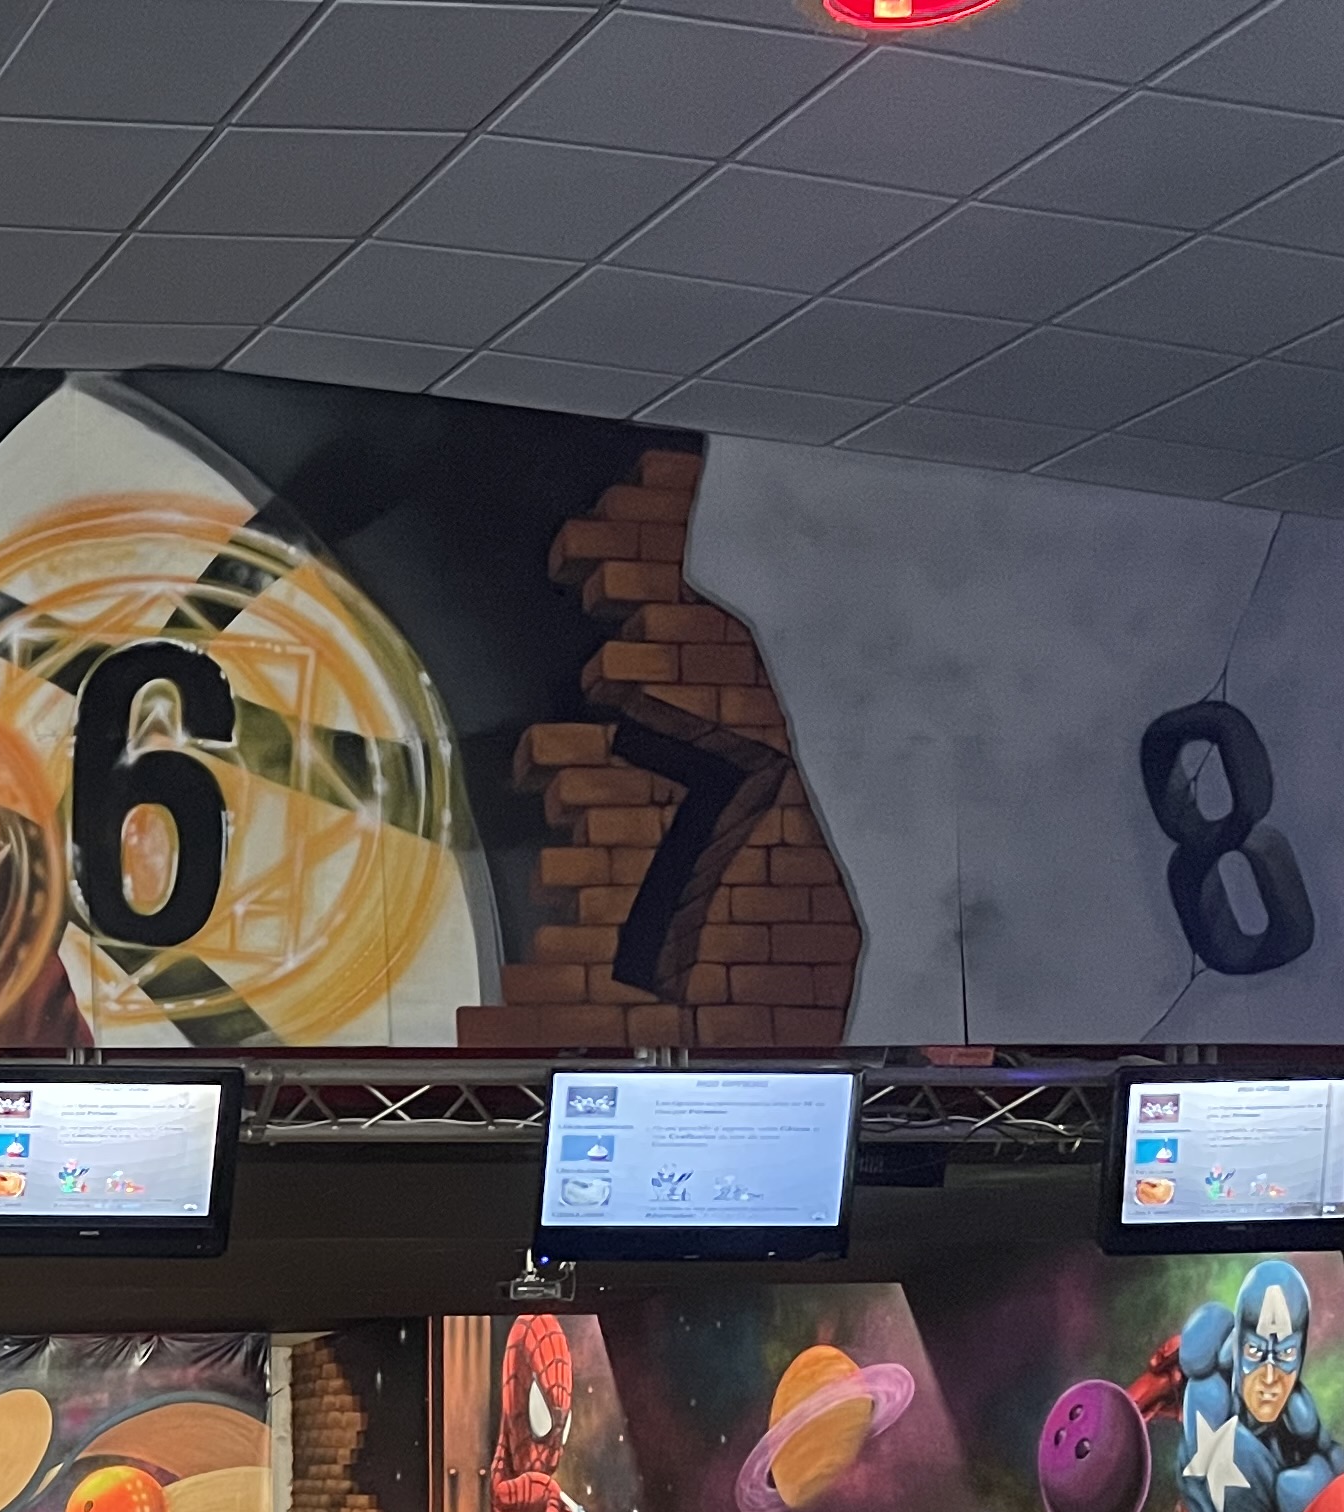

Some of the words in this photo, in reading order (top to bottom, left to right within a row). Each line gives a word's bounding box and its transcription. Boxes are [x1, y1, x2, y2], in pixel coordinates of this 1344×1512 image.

[70, 641, 236, 949] 6
[610, 700, 782, 1001] 7
[1139, 700, 1314, 977] 8
